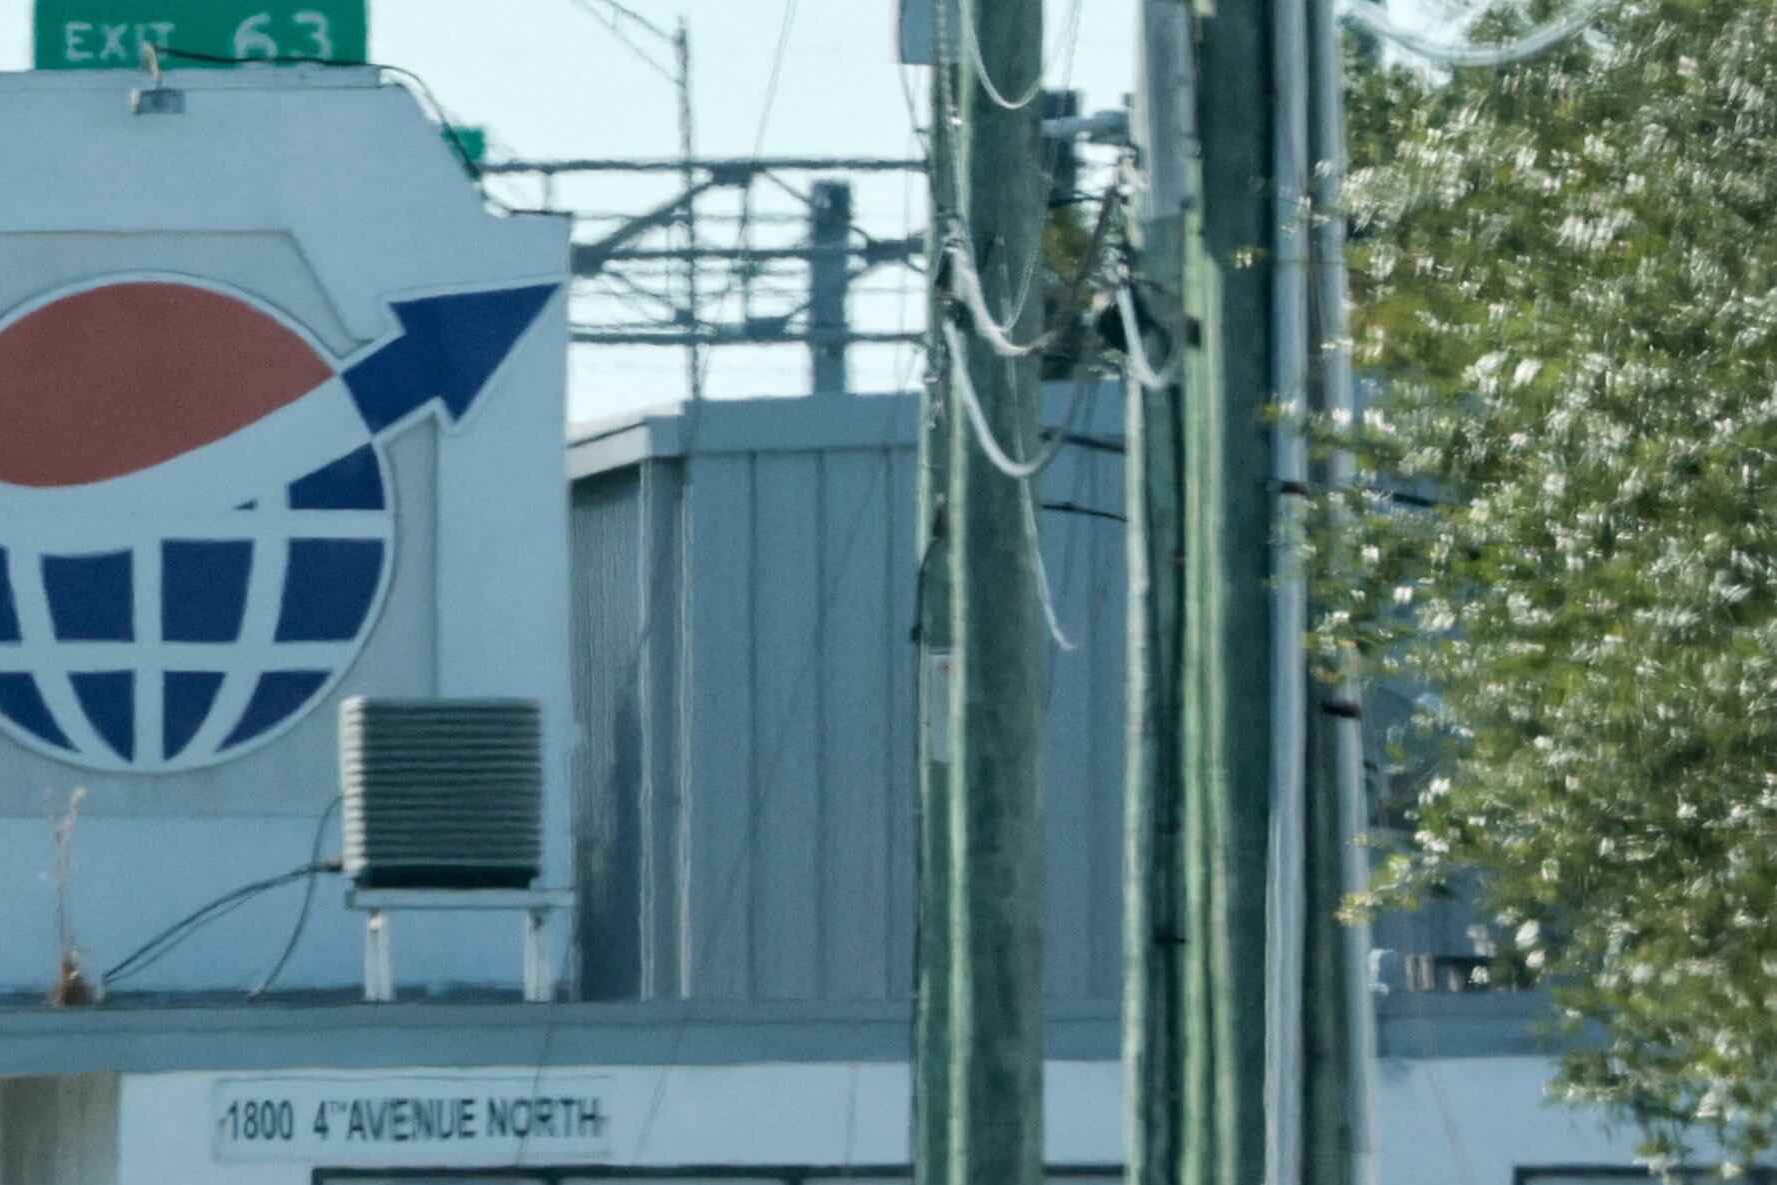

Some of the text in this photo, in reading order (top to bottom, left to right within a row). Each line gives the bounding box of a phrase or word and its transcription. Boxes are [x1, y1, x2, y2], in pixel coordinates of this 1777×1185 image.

[65, 11, 335, 62] EXIT 63
[227, 1100, 294, 1141] 1800
[347, 1098, 477, 1142] AVENUE
[486, 1098, 600, 1139] NORTH
